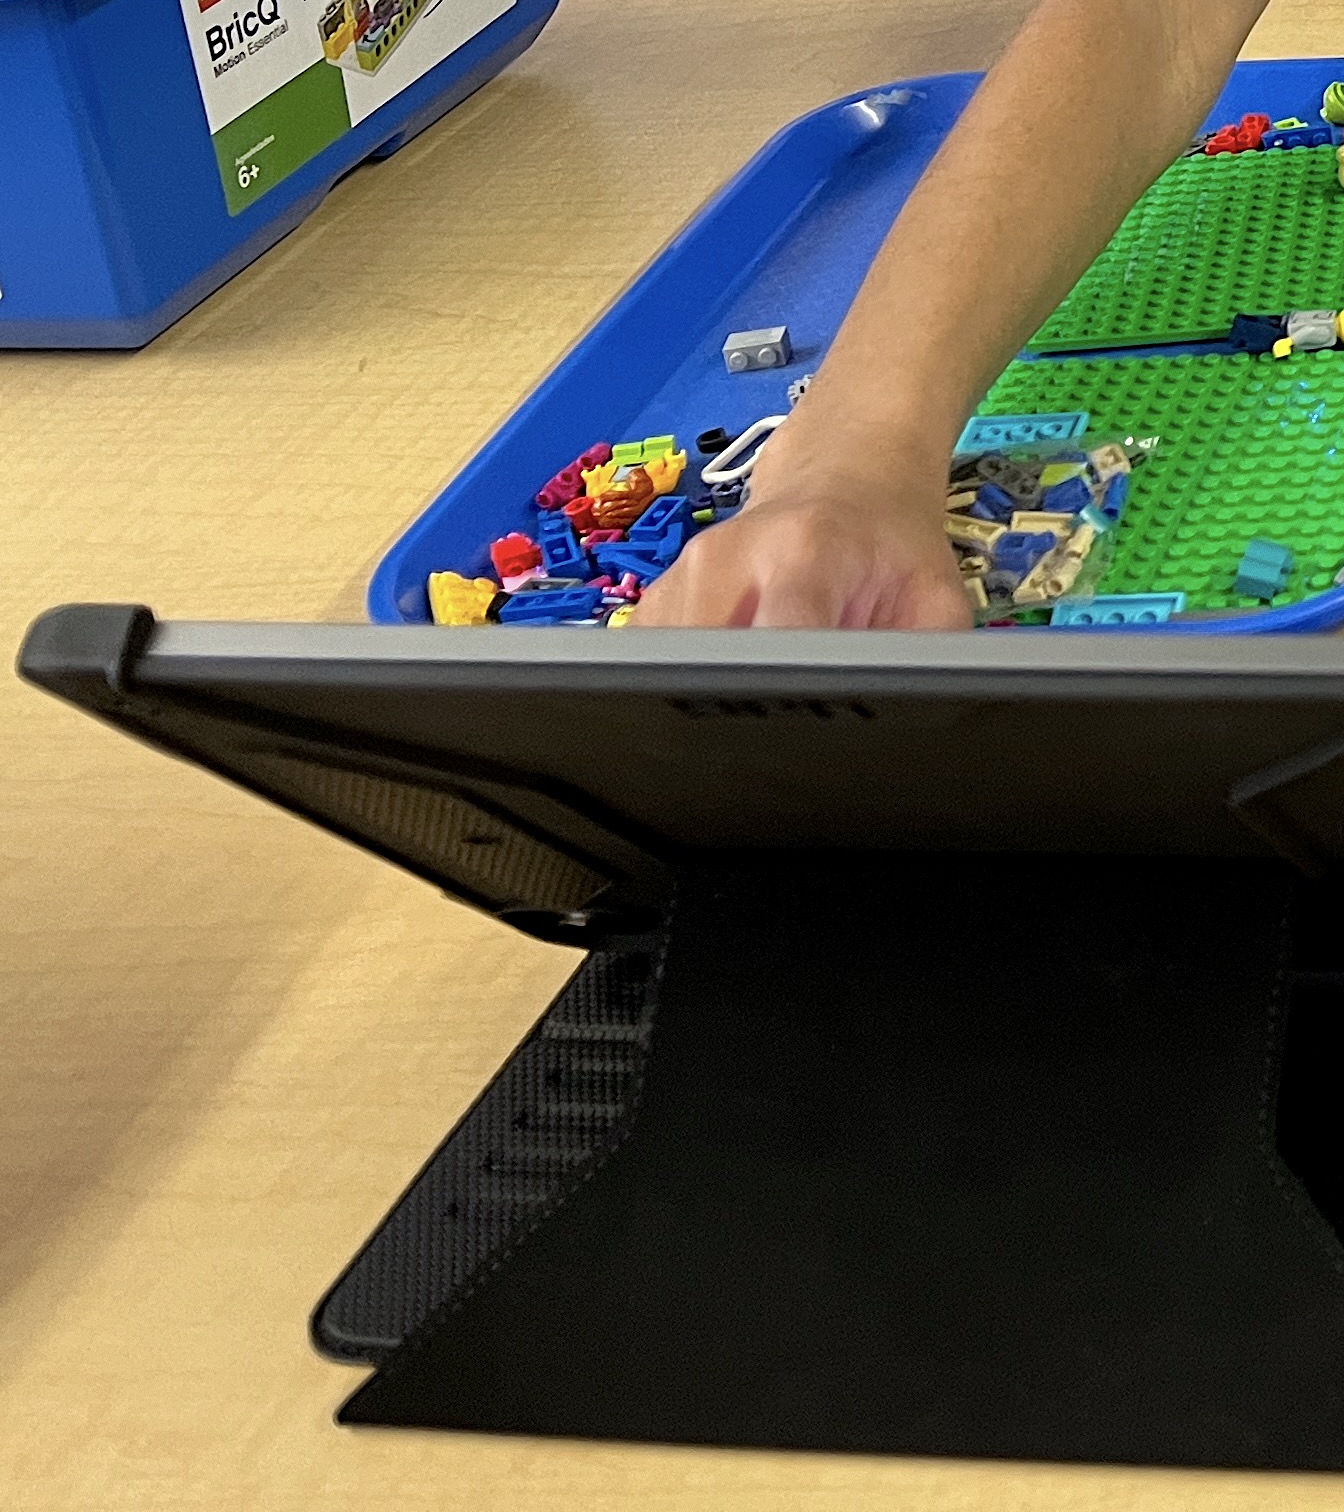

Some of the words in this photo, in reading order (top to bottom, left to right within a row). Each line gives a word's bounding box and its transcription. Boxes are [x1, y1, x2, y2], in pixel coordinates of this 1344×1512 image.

[213, 51, 246, 78] Motion
[247, 19, 289, 55] Essential
[238, 164, 260, 188] 6+
